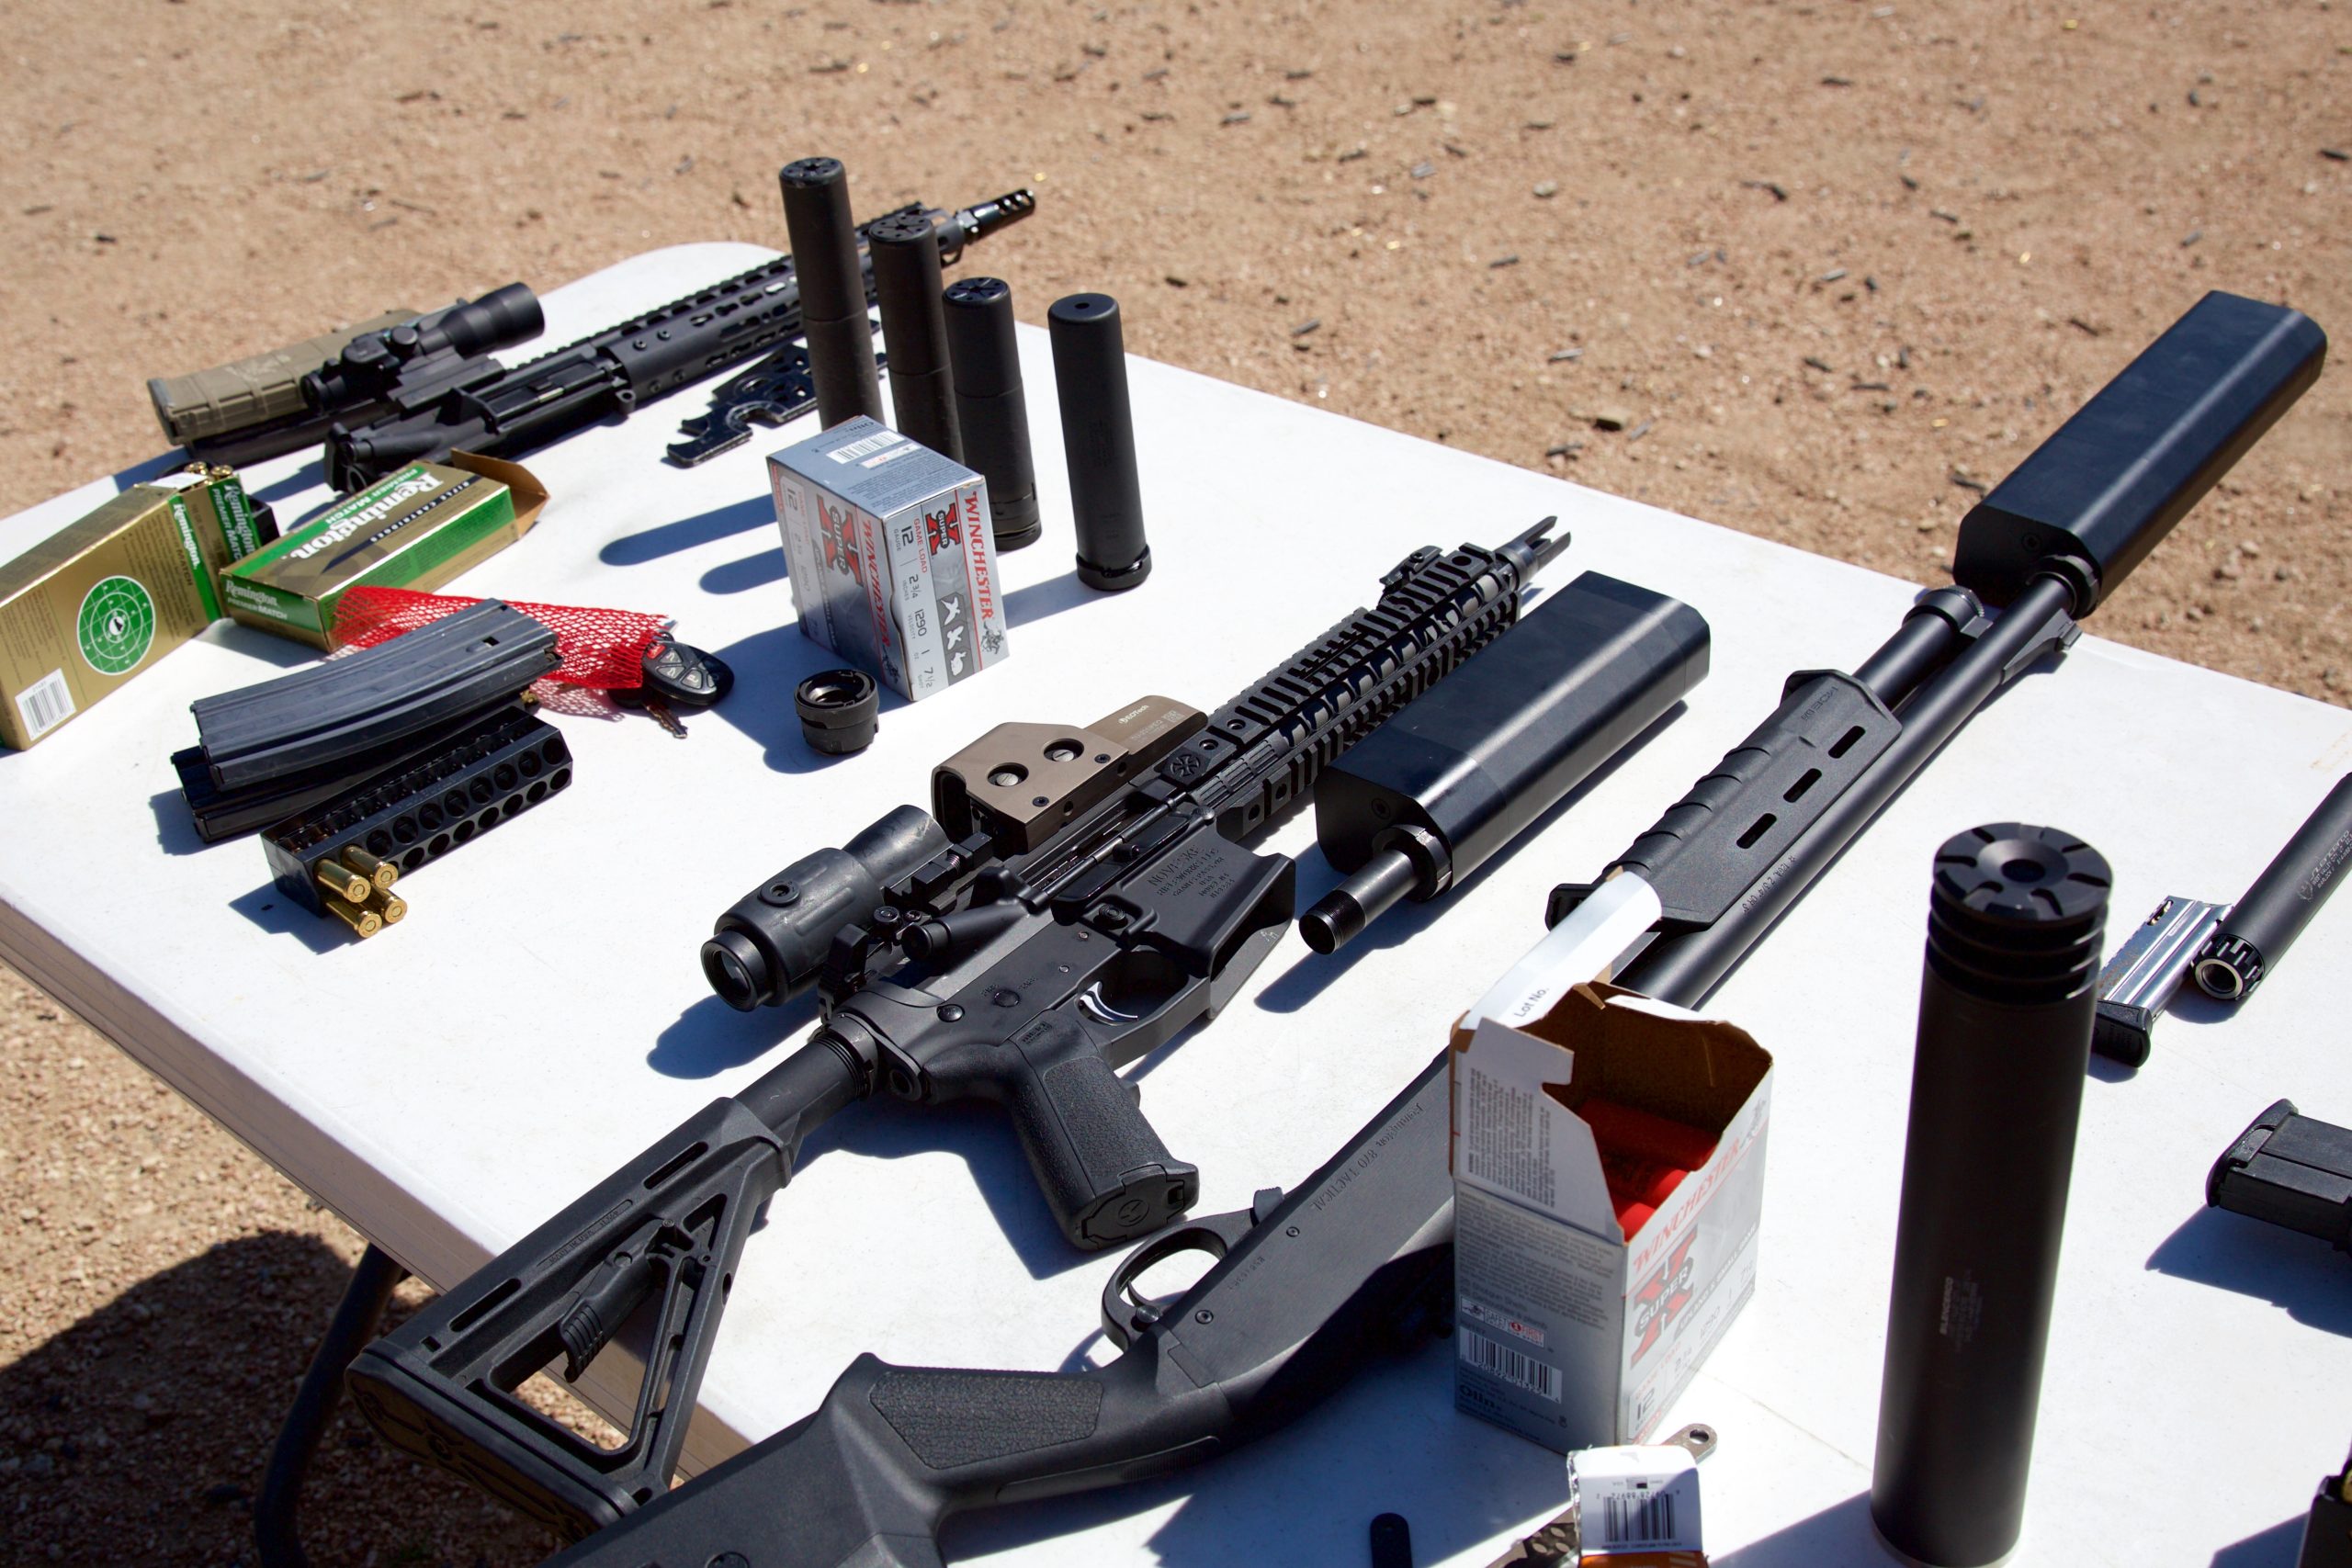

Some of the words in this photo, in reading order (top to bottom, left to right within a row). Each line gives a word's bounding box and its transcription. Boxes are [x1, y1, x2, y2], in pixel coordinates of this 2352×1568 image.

[291, 471, 444, 559] Remington
[787, 490, 798, 512] 12
[173, 503, 199, 567] Remington
[226, 529, 243, 561] MATC
[831, 512, 846, 570] SUPER
[914, 518, 924, 546] GAME
[919, 547, 927, 573] LOAD
[937, 512, 947, 547] SUPER
[964, 491, 994, 621] WINCHESTER
[226, 579, 277, 606] Remington
[863, 518, 890, 648] WINCHESTER
[900, 525, 914, 547] 12
[915, 608, 927, 637] 1290
[1513, 1002, 1534, 1017] Lot
[1357, 1148, 1378, 1168] 870
[1308, 1169, 1360, 1213] TACTICAL
[1634, 1137, 1740, 1273] WINCHESTER
[1639, 1263, 1689, 1330] SUPER
[1637, 1388, 1656, 1420] 12
